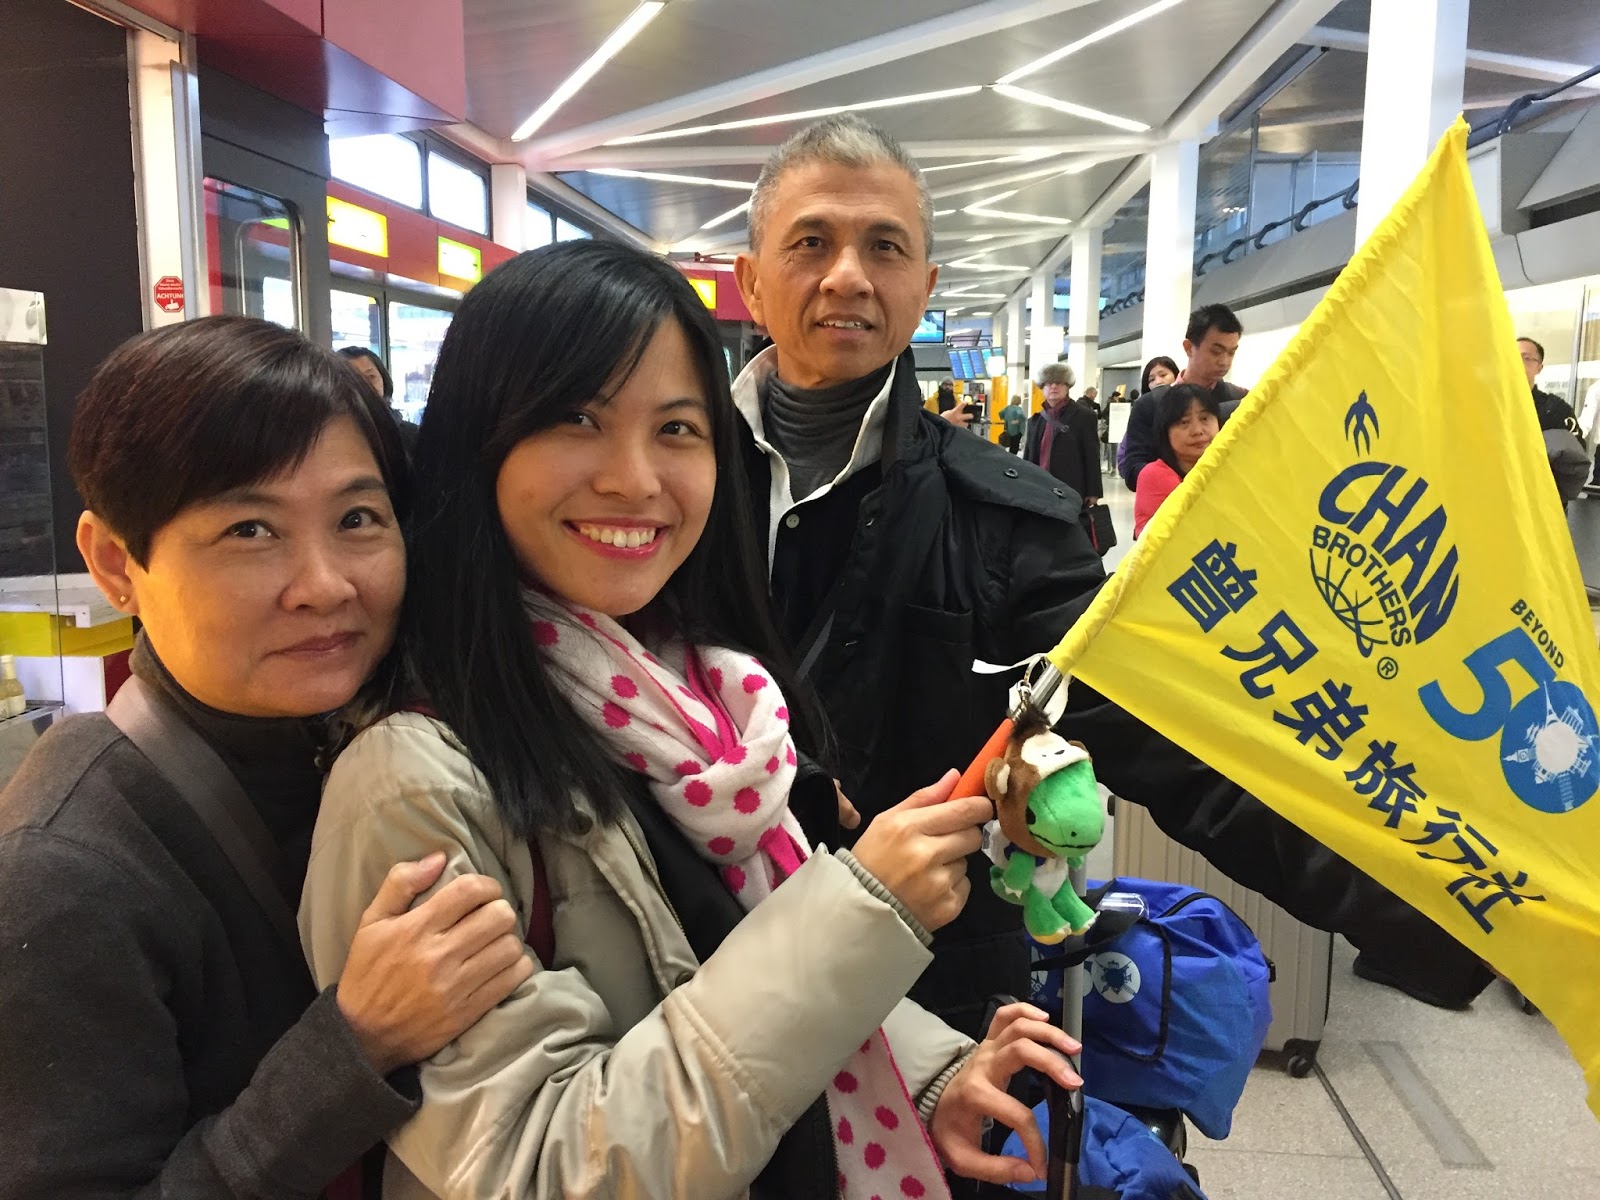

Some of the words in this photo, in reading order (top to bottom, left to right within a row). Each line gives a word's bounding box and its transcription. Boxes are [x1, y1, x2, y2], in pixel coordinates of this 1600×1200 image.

[1312, 524, 1412, 647] BROTHERS
[1318, 461, 1459, 645] CHAN
[1510, 599, 1564, 668] BEYOND
[1166, 538, 1546, 934] 曾兄弟旅行社
[1417, 626, 1600, 814] 50
